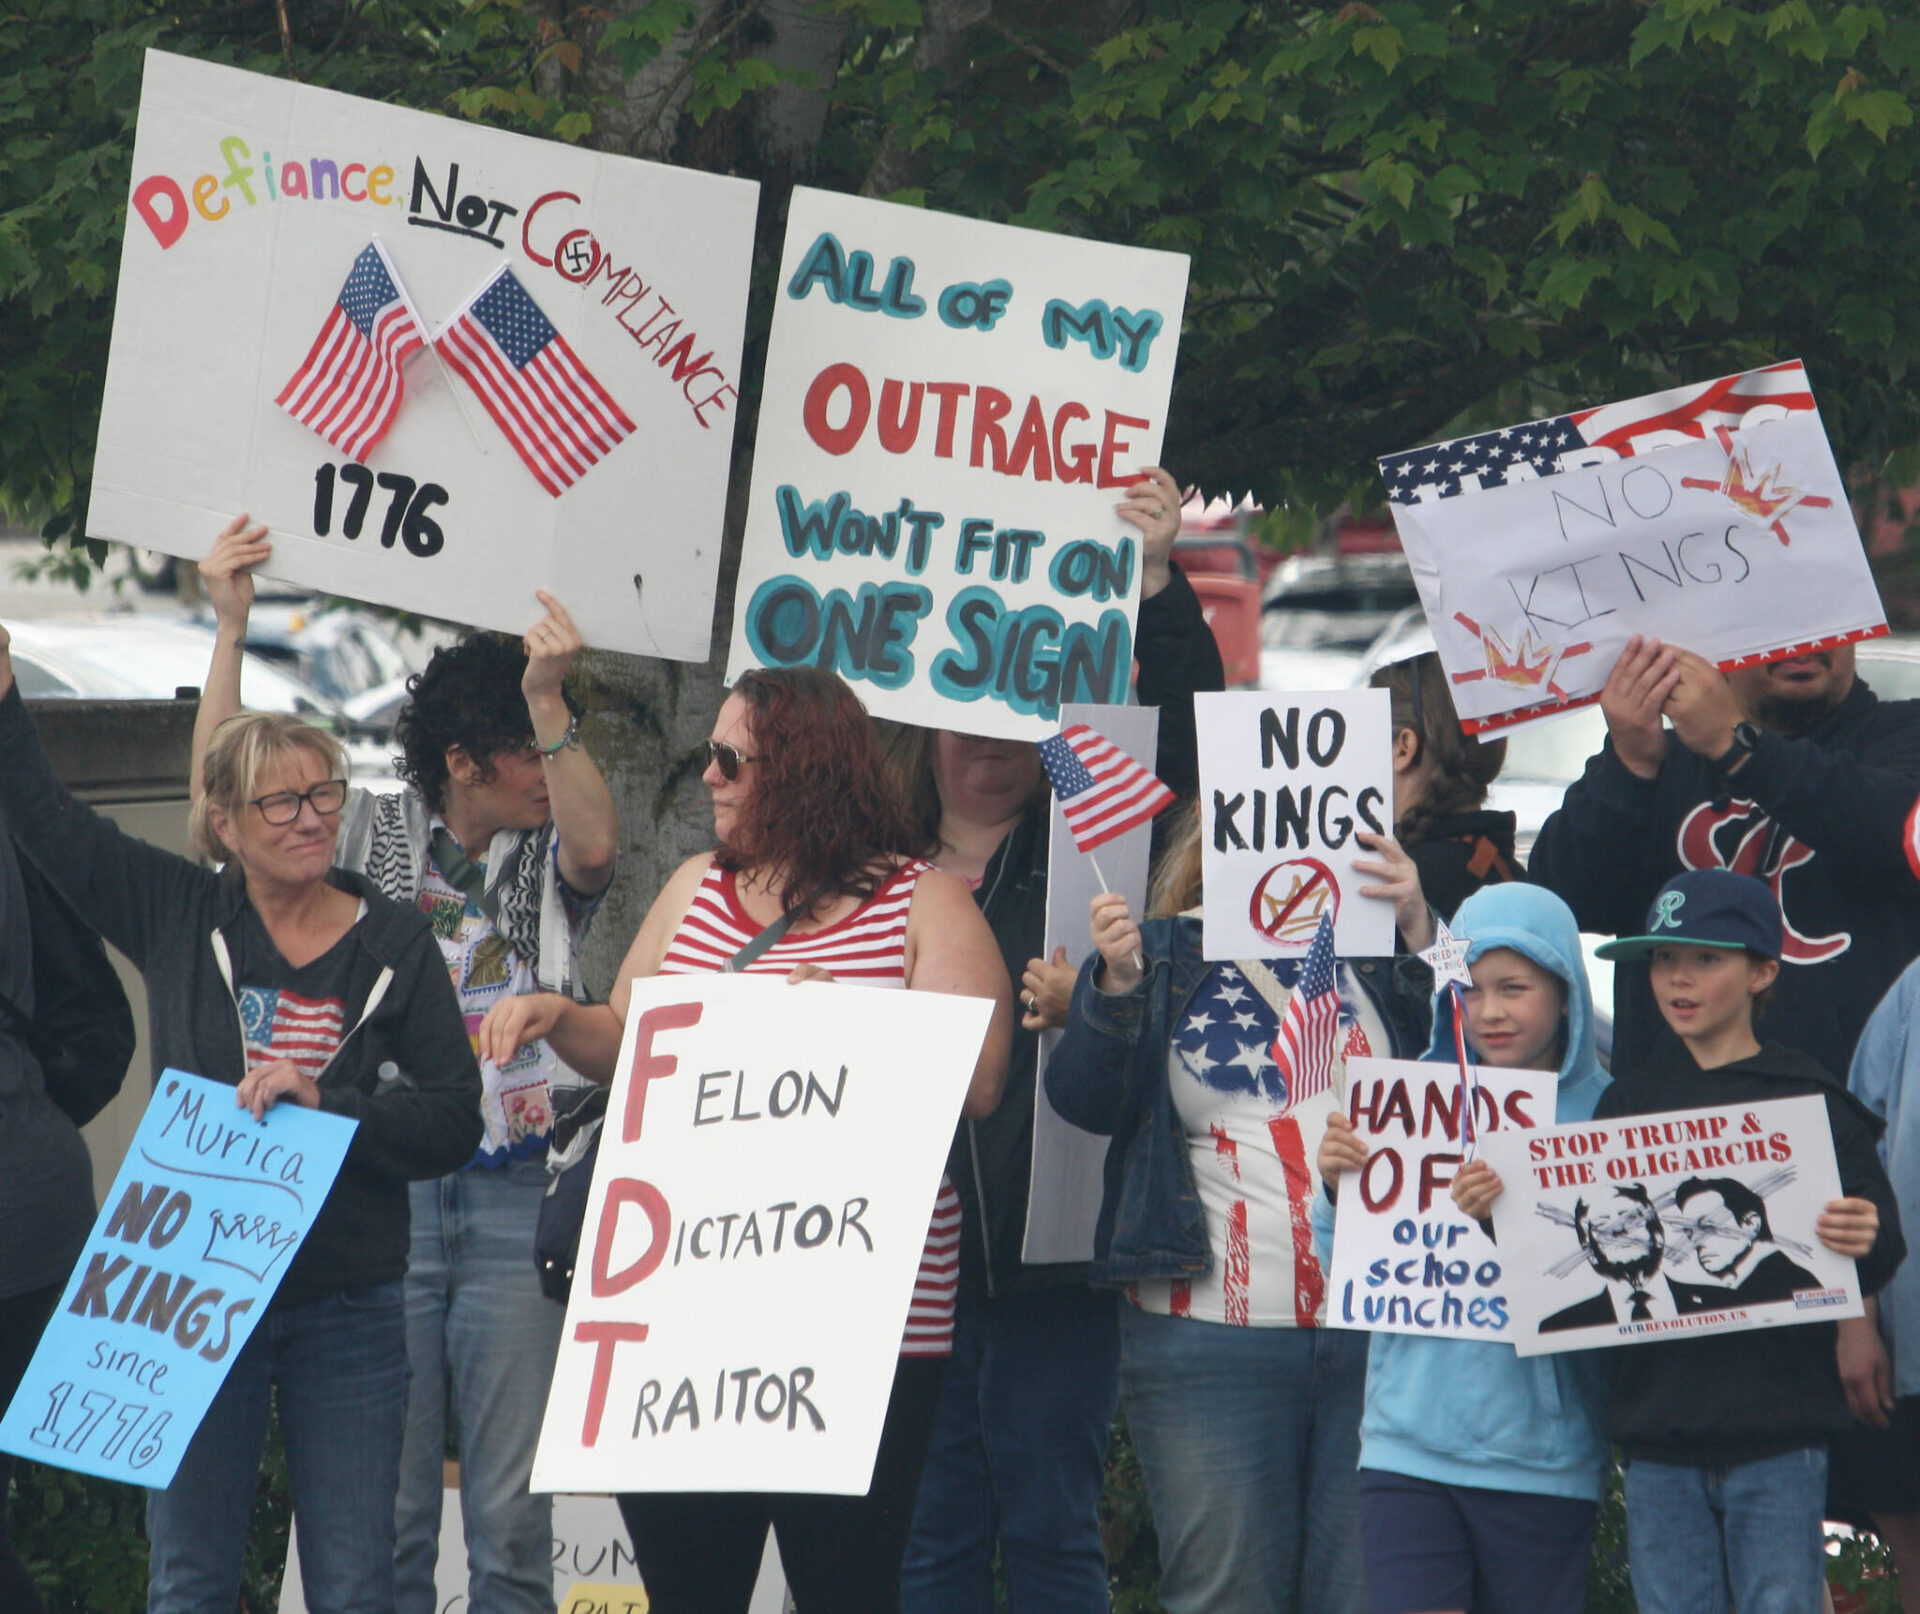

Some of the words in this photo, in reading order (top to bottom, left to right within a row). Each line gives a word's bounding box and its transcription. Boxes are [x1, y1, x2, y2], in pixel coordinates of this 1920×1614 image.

[408, 155, 518, 240] NOT
[522, 191, 738, 430] COMPLIANCE
[787, 232, 926, 319] ALL
[938, 279, 1013, 331] OF
[1042, 298, 1162, 372] MY
[803, 362, 1150, 490] OUTRAGE
[313, 462, 449, 557] 1776
[1551, 465, 1673, 542] NO
[955, 518, 1045, 583] FIT
[1049, 537, 1135, 602] ON
[1507, 524, 1750, 639] KINGS
[745, 575, 933, 690] ONE
[929, 584, 1132, 722] SIGN
[1260, 707, 1346, 770] NO
[1213, 784, 1386, 854] KINGS
[1651, 890, 1686, 932] R
[622, 1002, 848, 1144] FELON
[1350, 1078, 1537, 1143] HANDS
[1529, 1132, 1609, 1162] STOP
[1619, 1116, 1729, 1150] TRUMP
[1741, 1112, 1763, 1134] &
[1534, 1162, 1597, 1190] THE
[104, 1181, 192, 1249] NO
[1360, 1147, 1465, 1214] OF
[591, 1177, 874, 1299] DICTATOR
[1366, 1252, 1502, 1288] schoo
[67, 1252, 255, 1362] KINGS
[1342, 1278, 1509, 1331] lunches
[29, 1381, 173, 1470] 1776
[574, 1321, 826, 1449] TRAITOR
